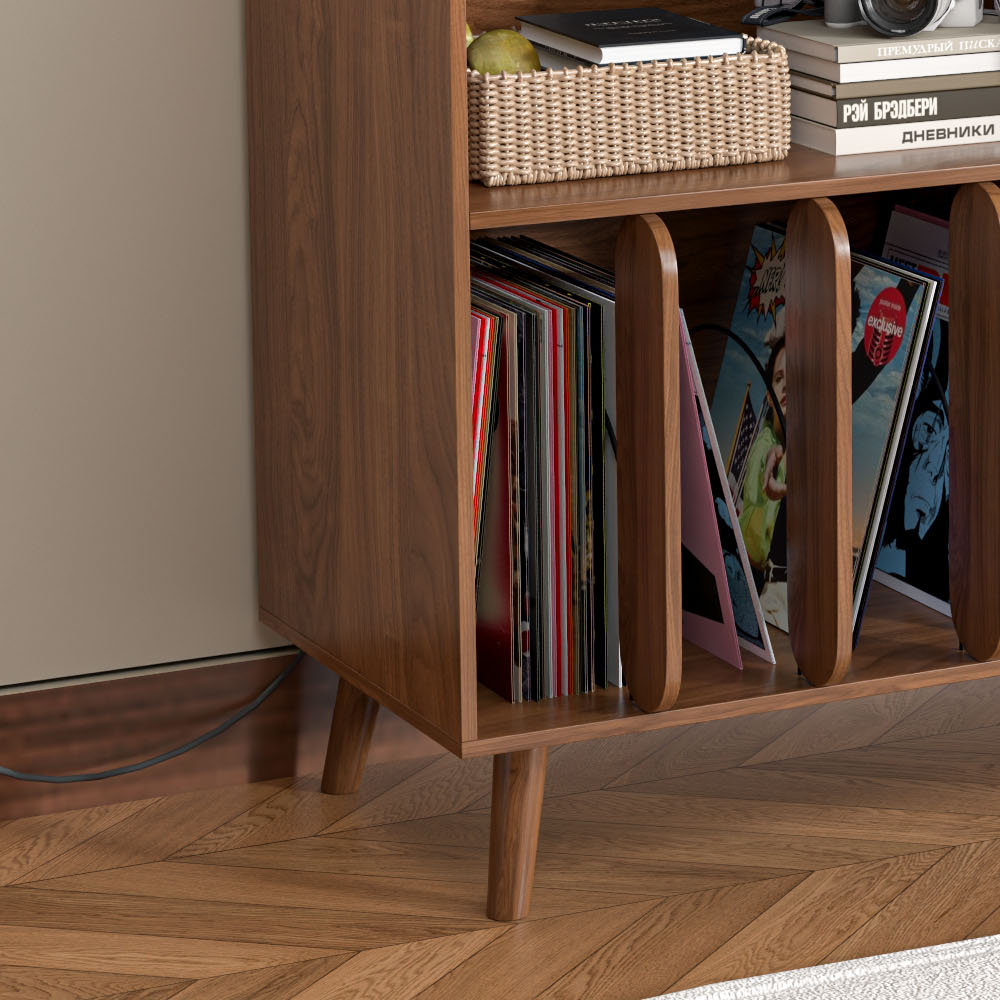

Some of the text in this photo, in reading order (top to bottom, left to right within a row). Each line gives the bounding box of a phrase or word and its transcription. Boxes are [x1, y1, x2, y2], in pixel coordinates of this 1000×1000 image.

[877, 40, 953, 57] ПРЕМУДРЫЙ
[842, 97, 938, 123] РЭЙ БРЭДБЕРИ
[901, 123, 995, 145] ДНЕВНИКИ
[867, 314, 903, 338] exclusive
